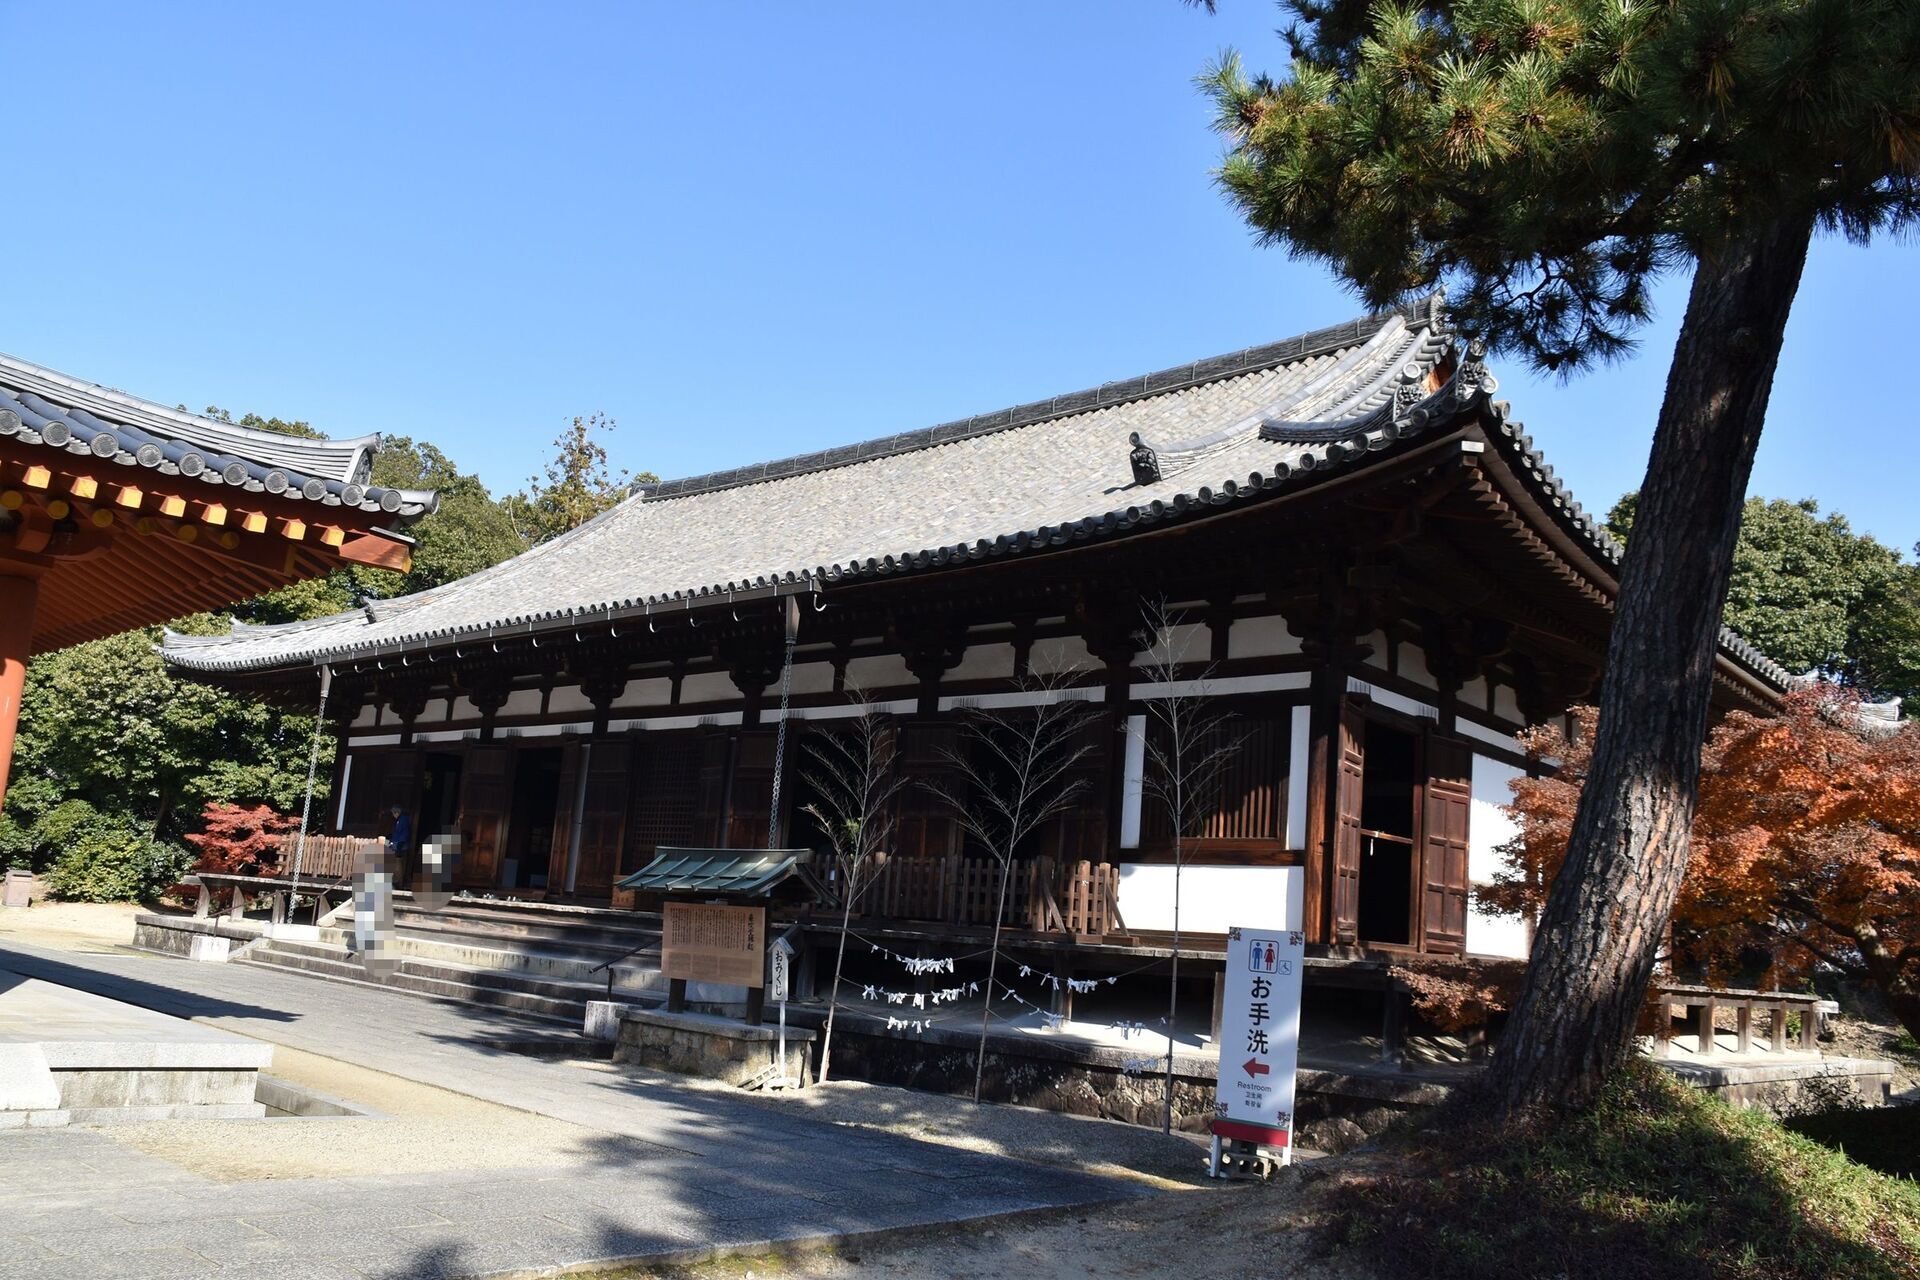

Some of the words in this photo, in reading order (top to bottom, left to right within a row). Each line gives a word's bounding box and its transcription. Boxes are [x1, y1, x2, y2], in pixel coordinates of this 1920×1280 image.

[775, 950, 783, 996] おみくじ
[1246, 976, 1272, 1055] お手洗
[1237, 1081, 1272, 1092] Restroom
